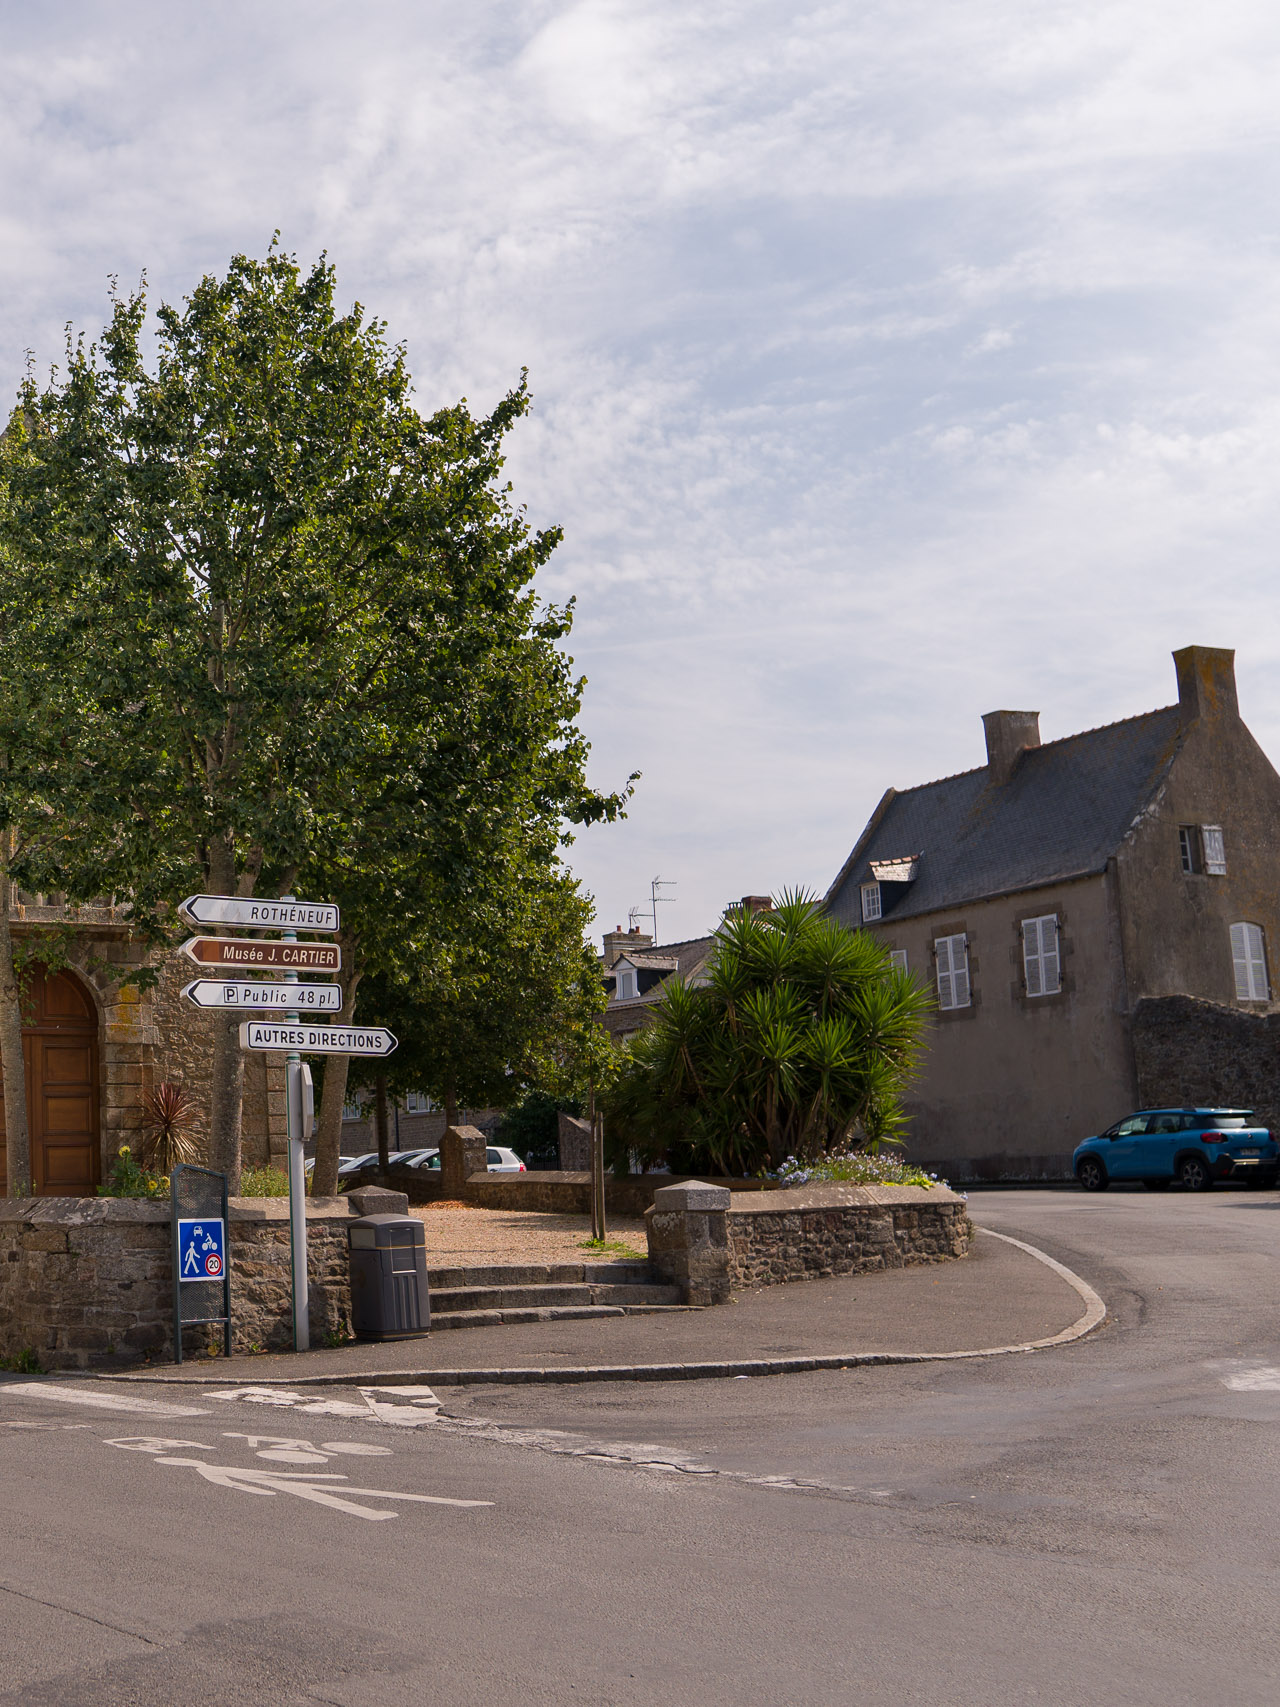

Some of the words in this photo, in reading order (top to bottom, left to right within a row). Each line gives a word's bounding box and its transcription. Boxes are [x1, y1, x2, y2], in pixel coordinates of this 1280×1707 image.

[251, 906, 332, 924] ROTHÉNEUF
[223, 946, 264, 960] Musée
[267, 948, 278, 962] J.
[282, 949, 334, 964] CARTIER
[243, 989, 287, 1003] Public
[297, 990, 315, 1004] 48
[318, 991, 335, 1006] pl.
[255, 1030, 304, 1044] AUTRES
[309, 1032, 382, 1048] DIRECTIONS
[209, 1260, 219, 1270] 20
